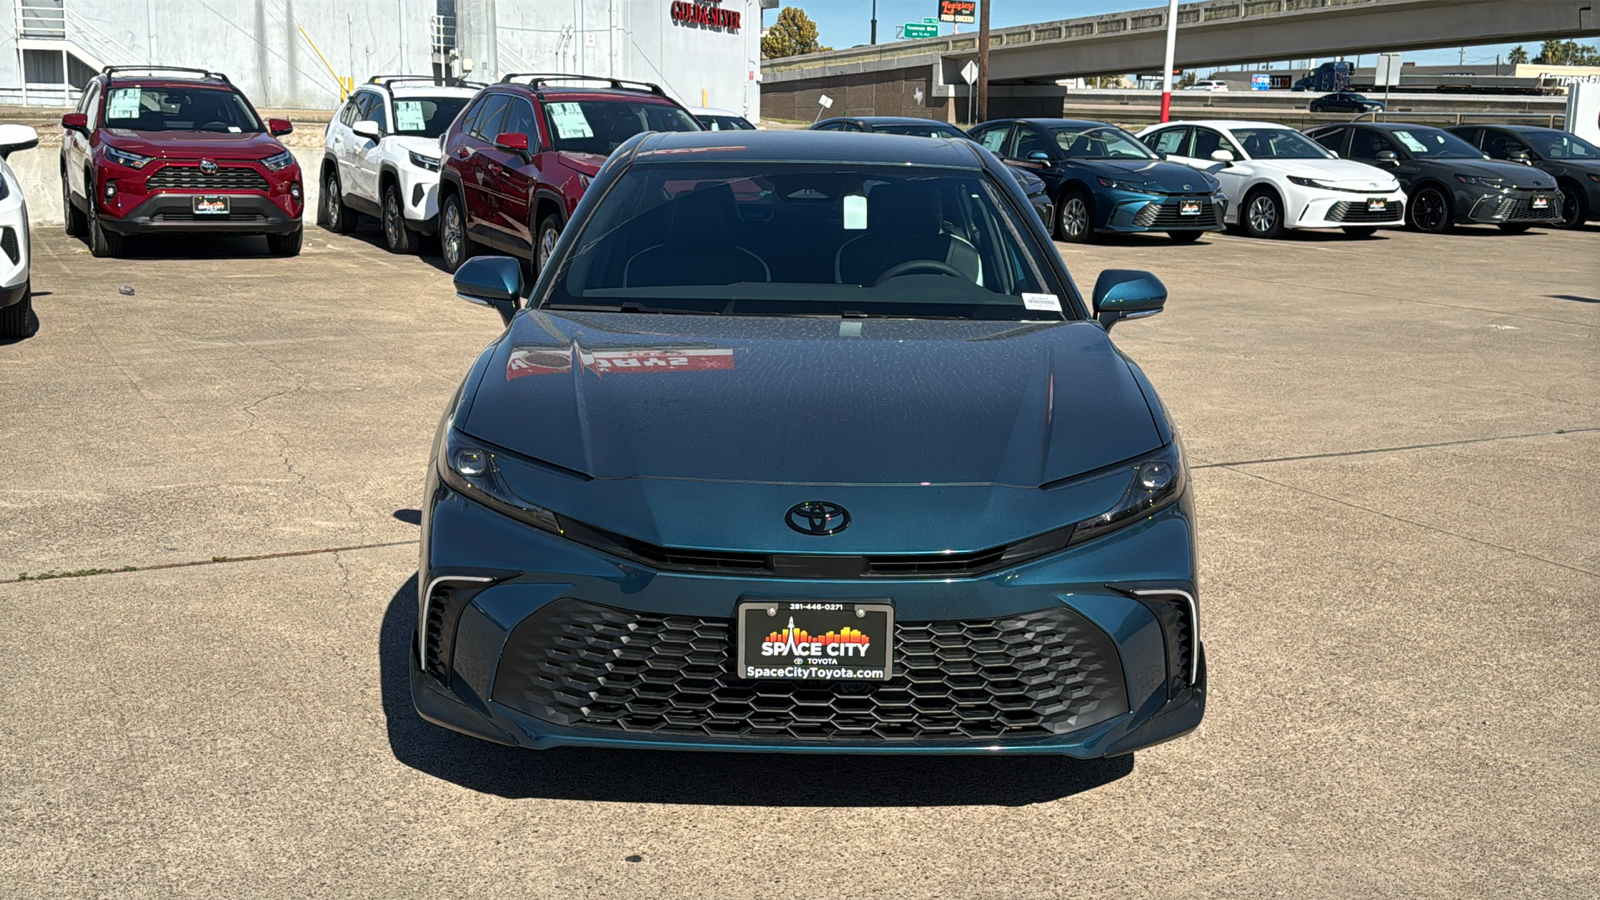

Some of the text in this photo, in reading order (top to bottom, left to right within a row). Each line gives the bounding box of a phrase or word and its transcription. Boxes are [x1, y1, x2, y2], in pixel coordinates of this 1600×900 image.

[761, 628, 870, 657] SPACE CITY
[747, 667, 884, 679] SpaceCityToyota.com
